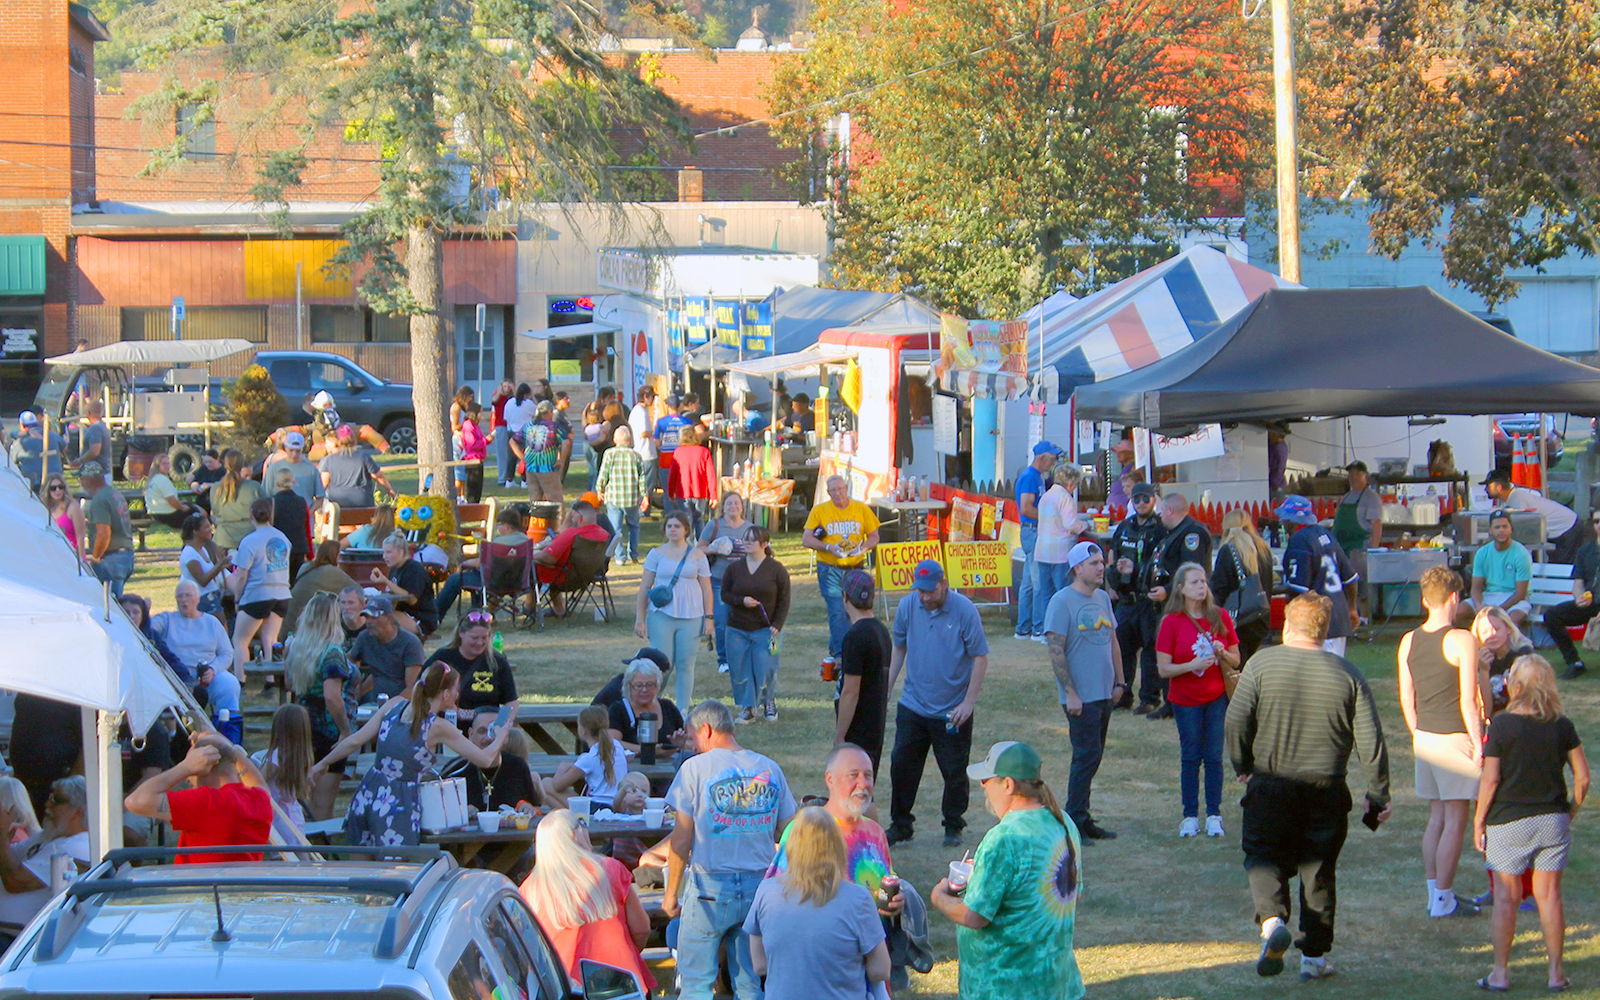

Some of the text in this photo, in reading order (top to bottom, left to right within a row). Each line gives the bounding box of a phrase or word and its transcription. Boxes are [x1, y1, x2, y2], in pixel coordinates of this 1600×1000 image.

[1157, 425, 1214, 450] BRISKET
[826, 520, 861, 536] SABRES
[880, 544, 941, 566] ICE CREAM
[948, 543, 1007, 557] CHICKEN TENDERS
[960, 558, 997, 570] WITH FRIES
[1321, 552, 1343, 593] 3
[891, 567, 915, 586] CON
[716, 779, 777, 801] RON JON
[713, 813, 733, 826] ONE
[735, 817, 748, 826] OF
[750, 818, 756, 826] A
